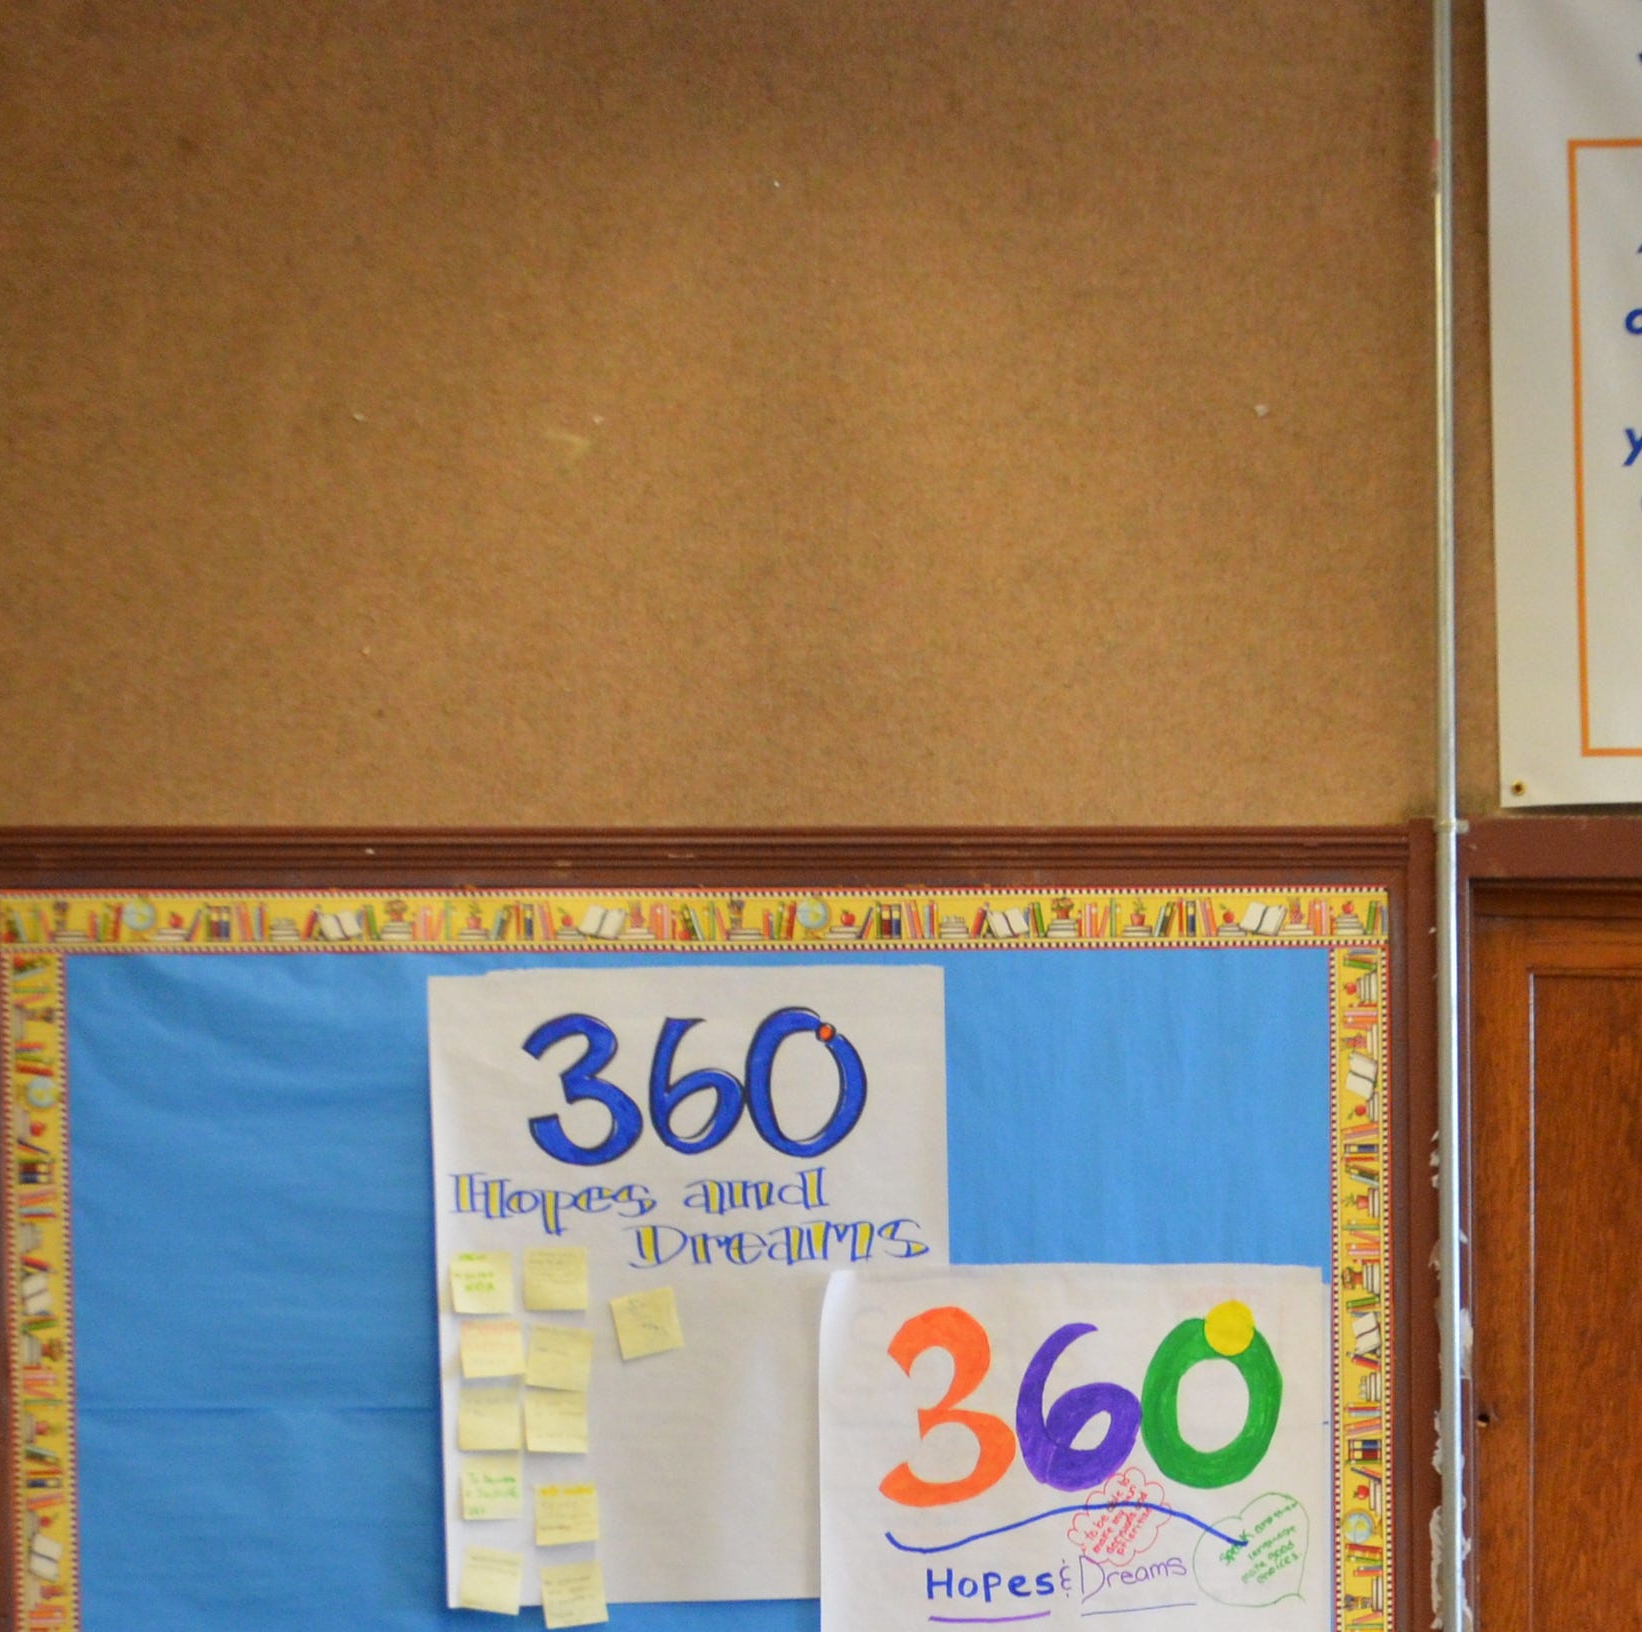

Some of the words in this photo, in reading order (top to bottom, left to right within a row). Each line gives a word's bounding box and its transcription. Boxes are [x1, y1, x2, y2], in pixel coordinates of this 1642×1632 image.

[449, 1170, 656, 1234] Hopes
[683, 1168, 828, 1214] and
[627, 1219, 930, 1270] Dreams
[925, 1565, 1056, 1602] Hopes
[1078, 1554, 1188, 1604] Dreams
